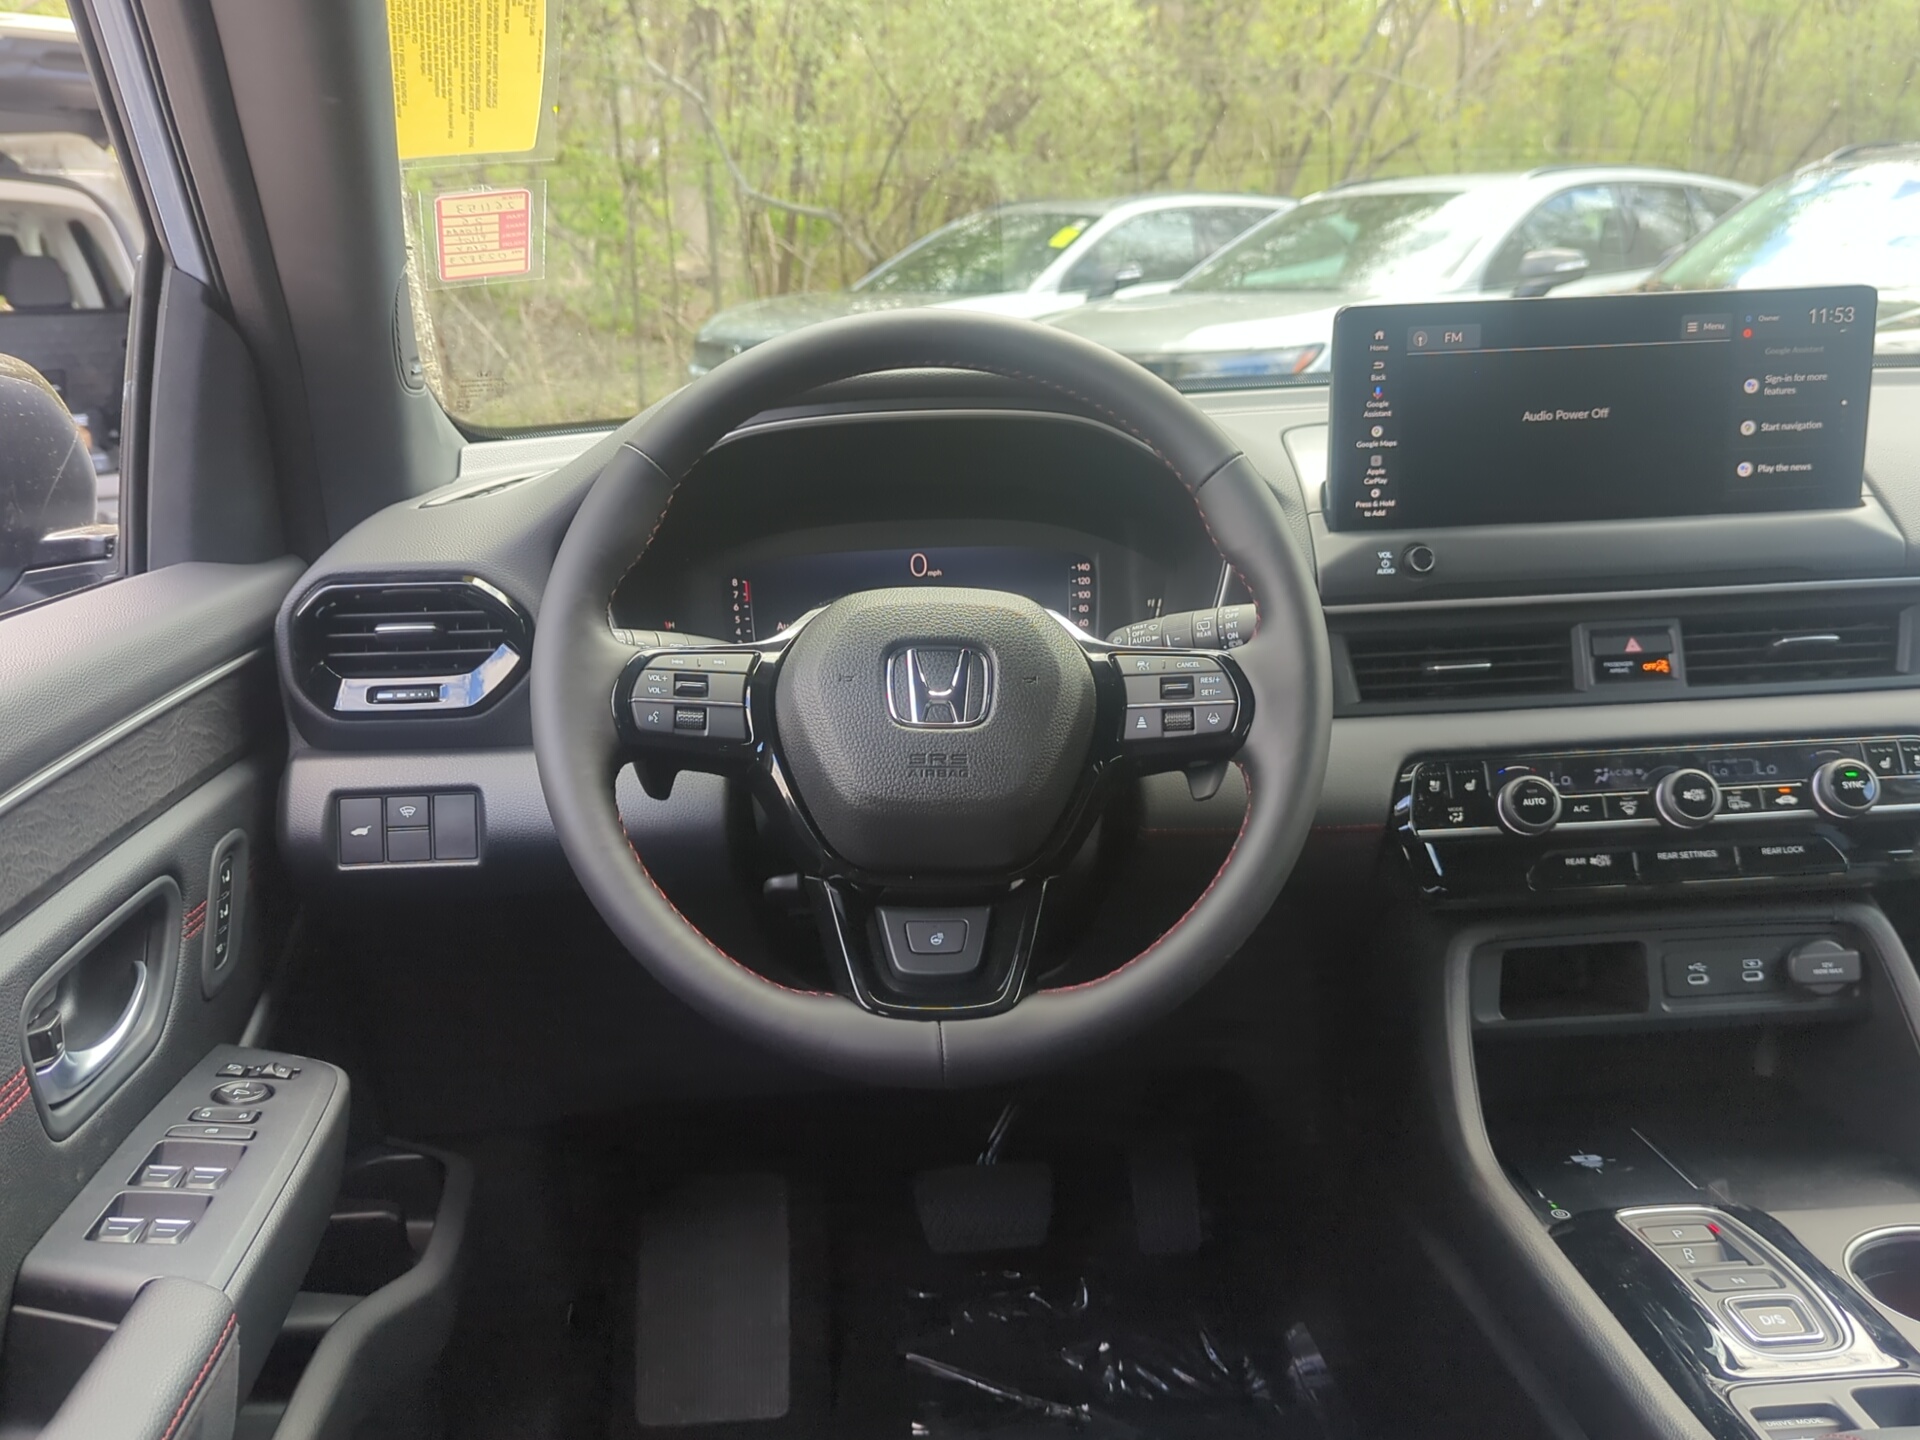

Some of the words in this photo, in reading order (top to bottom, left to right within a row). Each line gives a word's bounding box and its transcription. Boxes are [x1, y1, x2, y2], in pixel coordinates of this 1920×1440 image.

[1808, 306, 1855, 324] 11:53
[1703, 322, 1725, 331] Menu
[1444, 332, 1463, 343] FM
[1794, 374, 1806, 382] for
[1806, 374, 1828, 382] more
[1764, 387, 1796, 396] features
[1522, 410, 1554, 422] Audio
[1556, 409, 1590, 420] Power
[1591, 407, 1610, 418] Off
[1761, 422, 1780, 432] Start
[1781, 420, 1822, 432] navigation
[1356, 440, 1378, 449] Google
[1380, 440, 1398, 448] Maps
[1758, 464, 1775, 474] Play
[1776, 464, 1789, 472] the
[910, 552, 928, 578] 0
[928, 569, 942, 578] mph
[1077, 563, 1090, 572] 140
[732, 578, 738, 587] 8
[1078, 576, 1090, 585] 120
[733, 591, 738, 599] 7
[1078, 590, 1091, 599] 100
[733, 603, 740, 612] 6
[1078, 604, 1089, 613] 80
[734, 616, 740, 624] 5
[1078, 618, 1089, 627] 60
[1225, 621, 1238, 630] INT
[736, 628, 742, 636] 4
[1227, 632, 1239, 640] ON
[1132, 636, 1151, 644] AUTO
[909, 753, 968, 765] SRS
[908, 768, 968, 778] AIRBAG
[1842, 780, 1866, 790] SYNC
[1523, 798, 1546, 806] AUTO
[1783, 846, 1804, 854] LOCK
[1657, 852, 1678, 860] REAR
[1679, 850, 1718, 860] SETTINGS
[1565, 858, 1586, 866] REAR
[1672, 1229, 1682, 1238] P
[1682, 1248, 1695, 1260] R
[1758, 1314, 1786, 1326] D/S
[1766, 1419, 1794, 1428] DRIVE
[1796, 1417, 1824, 1426] MODE
